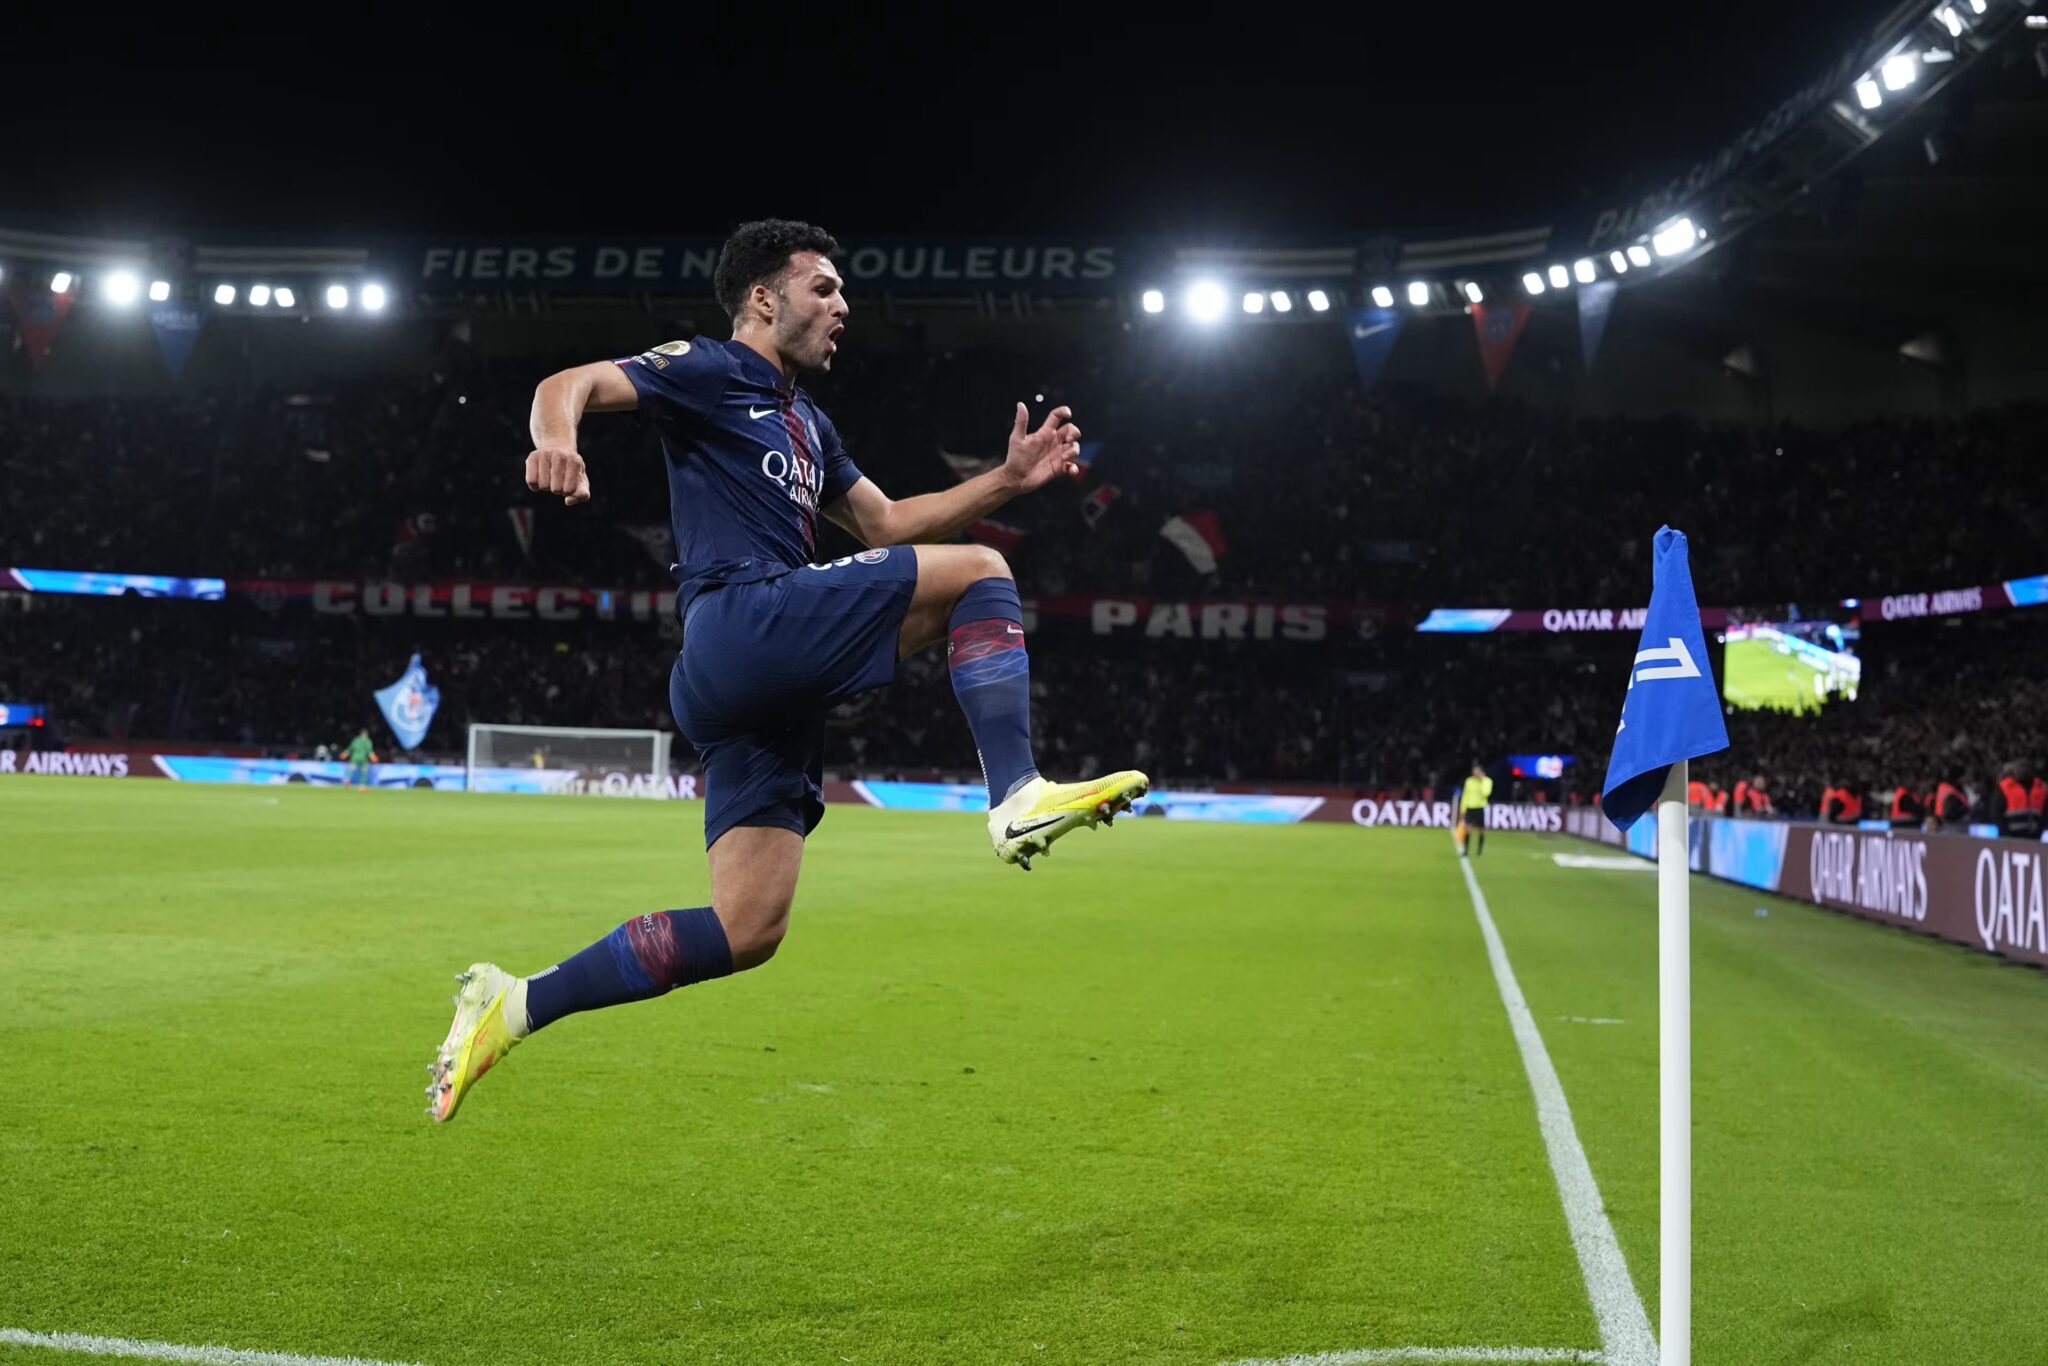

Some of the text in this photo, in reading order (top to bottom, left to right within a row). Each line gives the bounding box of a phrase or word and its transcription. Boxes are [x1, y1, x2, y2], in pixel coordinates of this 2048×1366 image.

[422, 248, 576, 279] FIERS
[594, 248, 663, 279] DE
[1091, 599, 1329, 641] PARIS
[1542, 609, 1613, 632] QATAR
[24, 751, 128, 777] AIRWAYS
[1352, 799, 1449, 827] QATAR
[1484, 804, 1562, 832] IRWAYS
[1975, 848, 2048, 954] QATA
